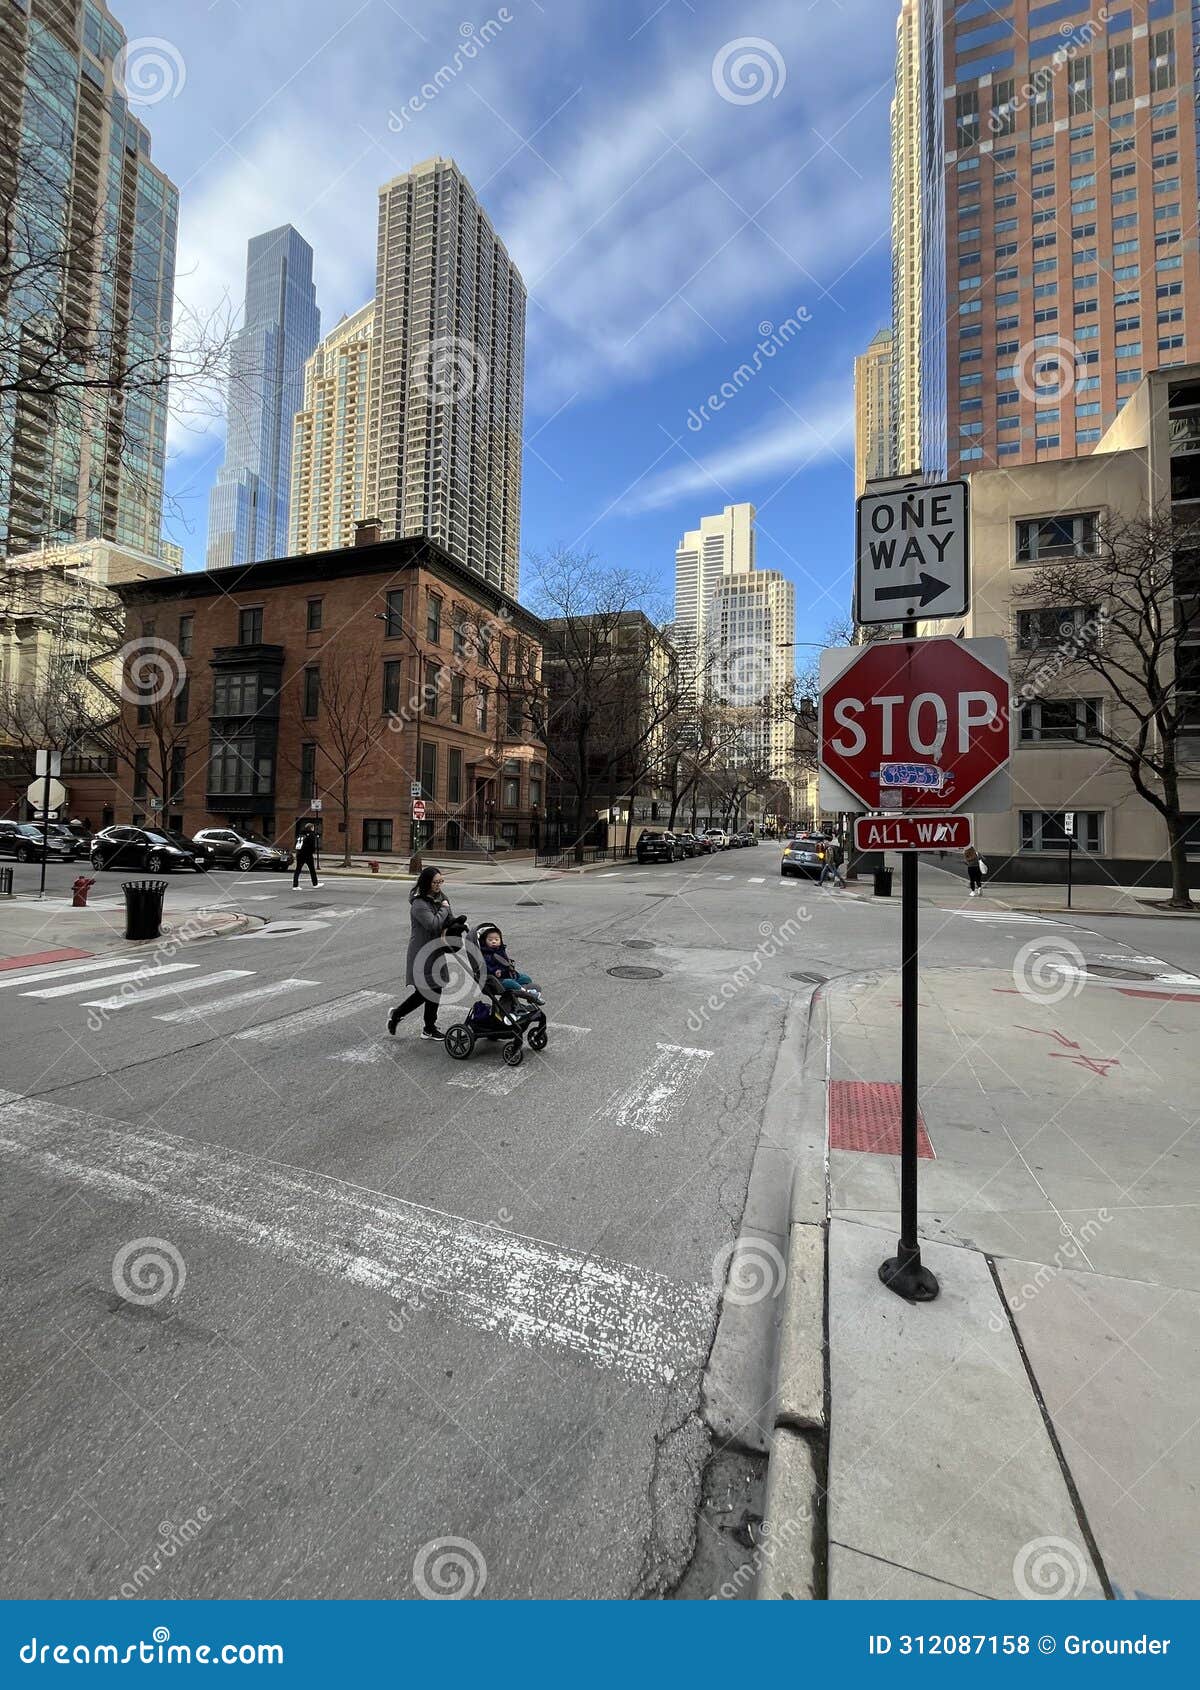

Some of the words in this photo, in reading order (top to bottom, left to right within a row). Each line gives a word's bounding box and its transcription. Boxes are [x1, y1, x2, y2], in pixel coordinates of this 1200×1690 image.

[871, 494, 953, 534] ONE
[868, 530, 956, 570] WAY
[830, 690, 998, 758] STOP
[867, 824, 909, 844] ALL
[916, 822, 960, 843] WAY
